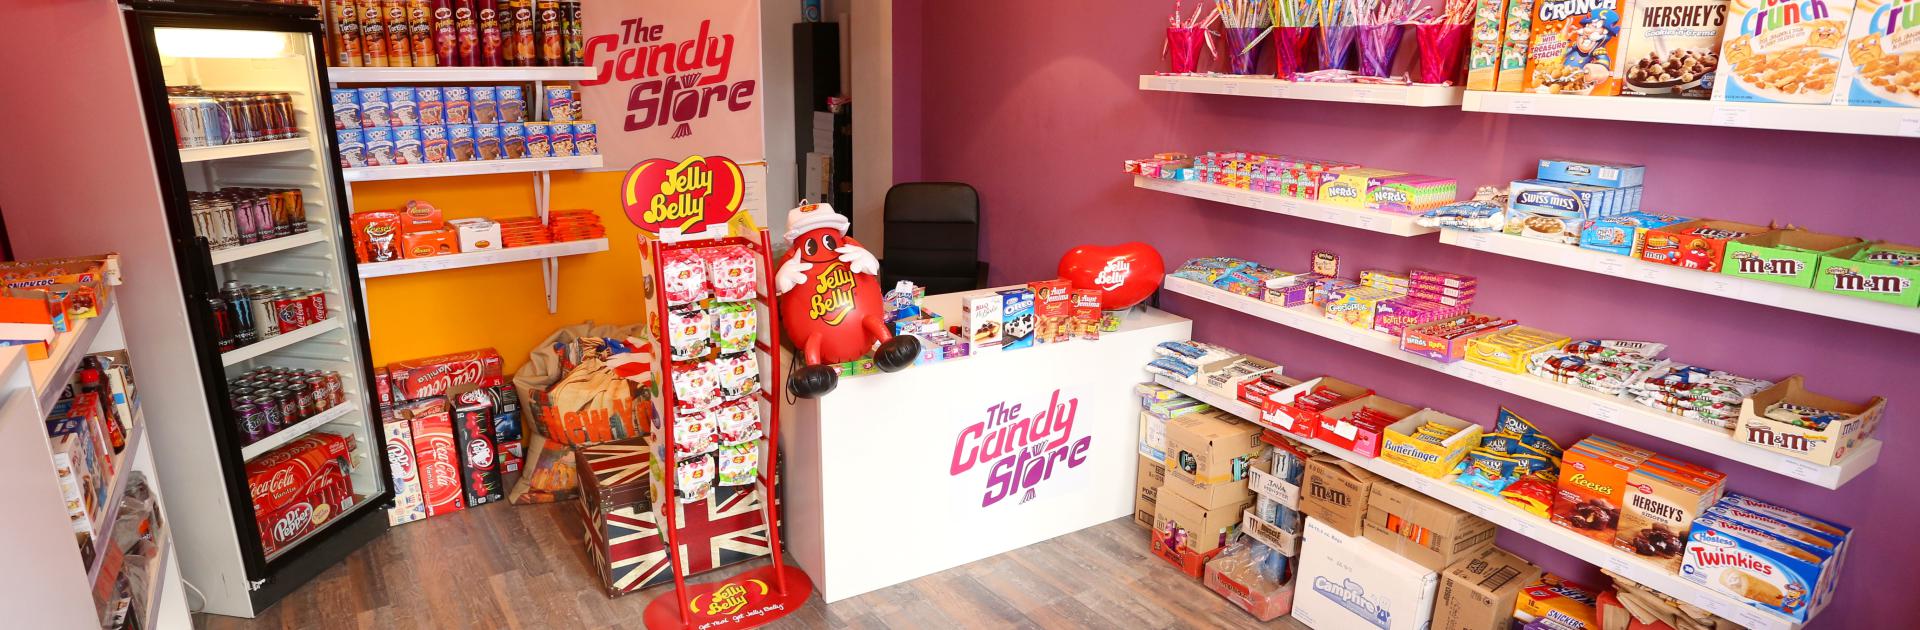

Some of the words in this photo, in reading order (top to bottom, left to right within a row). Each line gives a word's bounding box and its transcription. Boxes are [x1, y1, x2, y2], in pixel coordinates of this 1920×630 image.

[1642, 5, 1726, 28] HERSHEY'S
[1741, 0, 1829, 37] Crunch
[621, 17, 664, 45] The
[579, 19, 735, 87] Candy
[624, 74, 756, 133] Store
[661, 160, 713, 197] Jelly
[643, 192, 704, 224] Belly
[1521, 192, 1548, 206] SWISS
[1104, 258, 1130, 274] Jelly
[816, 265, 856, 295] Jelly
[1094, 271, 1125, 286] Belly
[1044, 293, 1069, 305] Jemima
[1050, 286, 1067, 296] Aunt
[1080, 294, 1098, 302] Aunt
[809, 287, 855, 320] Belly
[1004, 299, 1034, 316] OREO
[1074, 300, 1101, 309] Jemima
[417, 364, 452, 384] Vanilla
[987, 400, 1022, 430] The
[1505, 416, 1529, 430] JOLLY
[950, 389, 1079, 476] Candy
[1384, 439, 1440, 463] Butterfinger
[426, 464, 434, 489] Vanilla
[982, 436, 1092, 508] Store
[273, 487, 297, 500] Vanilla
[1569, 473, 1613, 496] Reese's
[286, 507, 300, 523] Dr
[1632, 494, 1684, 523] HERSHEY'S
[1731, 508, 1787, 528] Twinkies
[277, 507, 310, 542] Pepper
[1718, 520, 1777, 541] Twinkies
[1699, 532, 1733, 547] Hostess
[1691, 546, 1773, 576] Twinkies
[711, 584, 747, 602] Jelly
[1313, 575, 1376, 615] Campfire
[707, 595, 748, 615] Belly
[1547, 609, 1585, 629] SNICKERS
